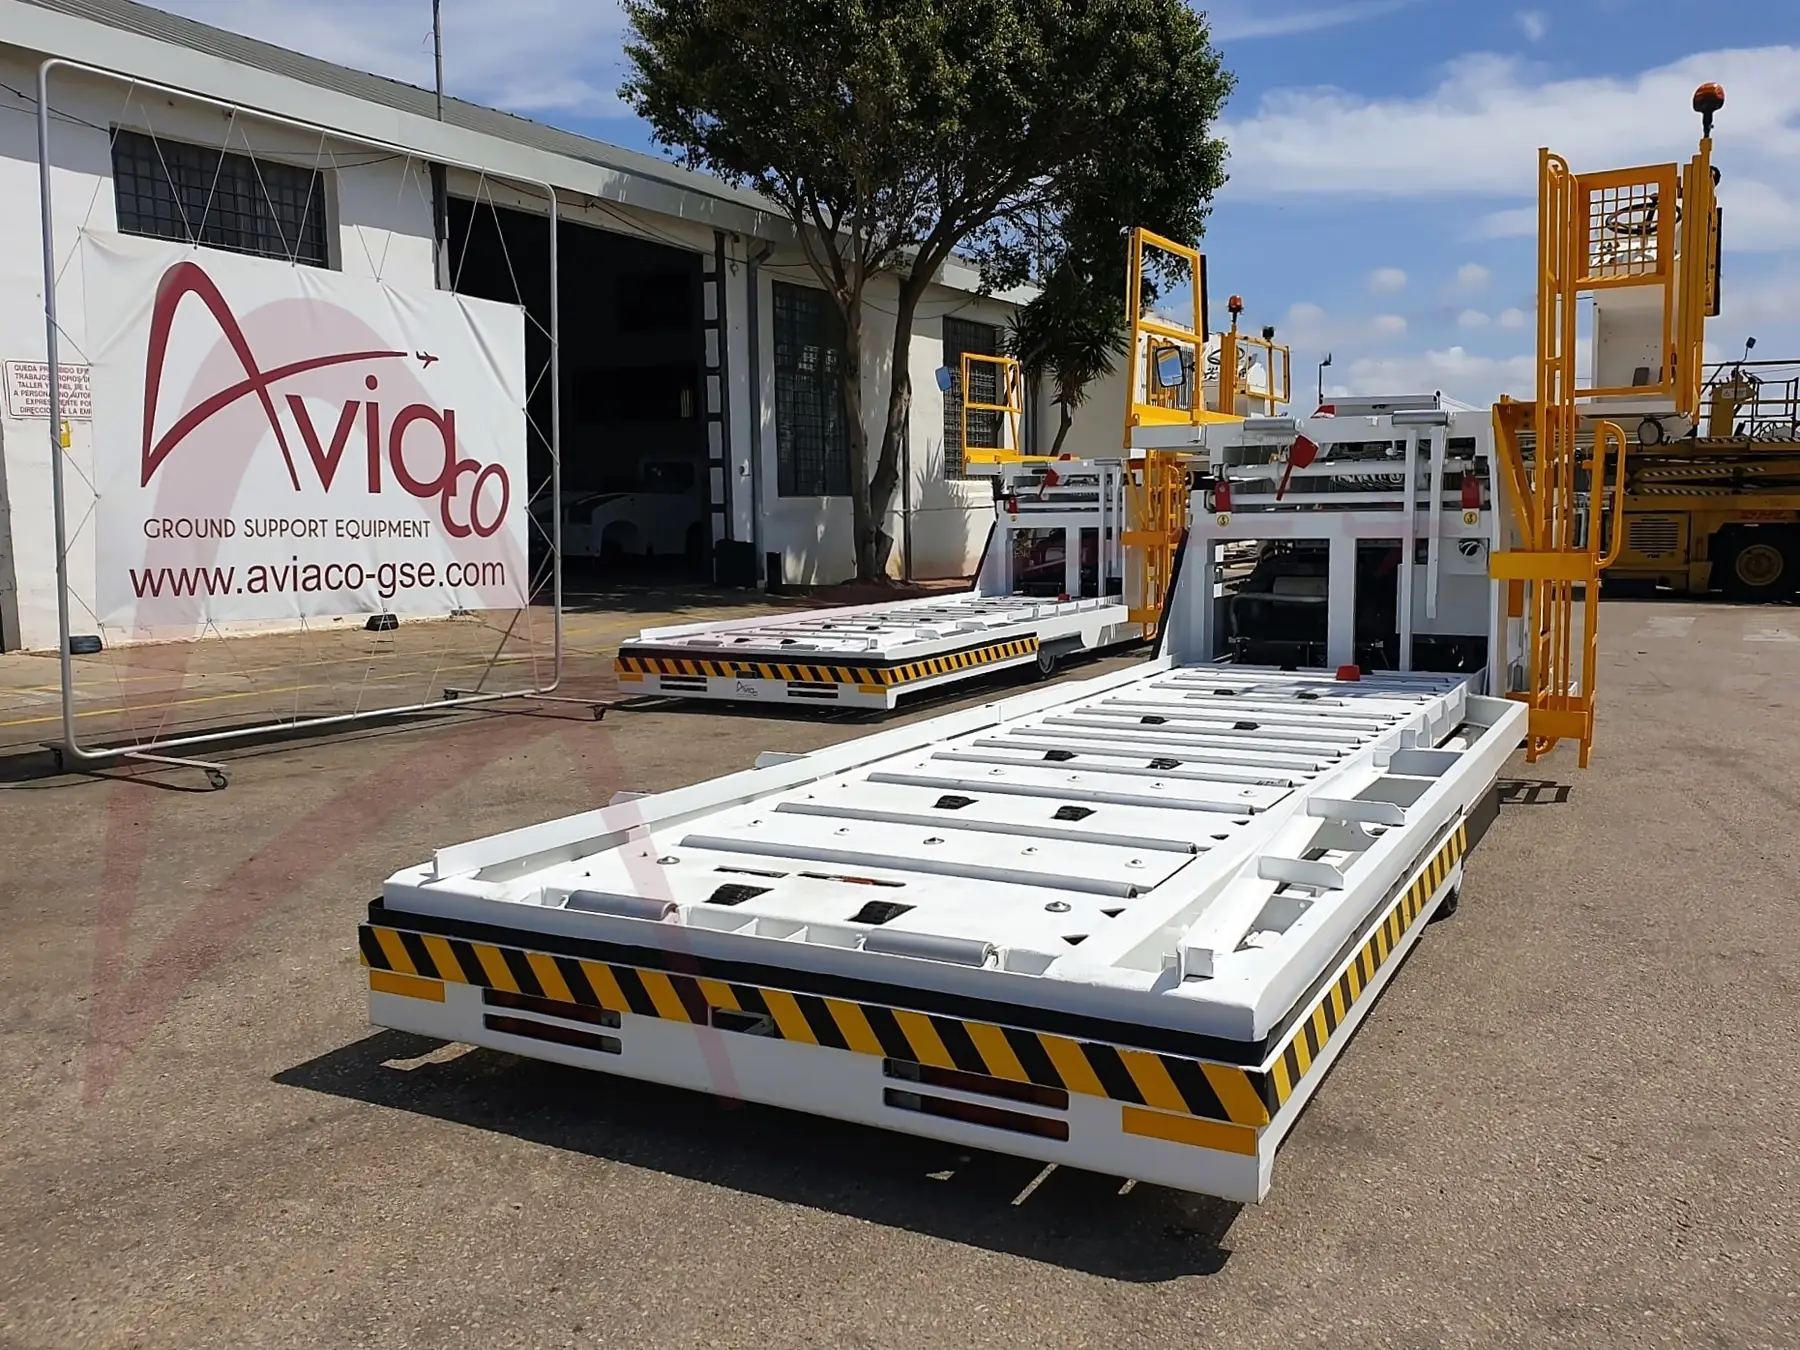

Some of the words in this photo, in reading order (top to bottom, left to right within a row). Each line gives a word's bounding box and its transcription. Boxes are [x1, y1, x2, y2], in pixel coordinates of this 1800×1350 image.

[14, 364, 37, 372] QUEDA
[17, 381, 43, 389] TALLER
[141, 261, 510, 538] Aviaco
[20, 406, 50, 414] DIRECCIO
[143, 517, 236, 539] GROUND
[243, 518, 328, 538] SUPPORT
[335, 518, 431, 541] EQUIPMENT
[129, 554, 506, 599] www.aviaco-gse.com
